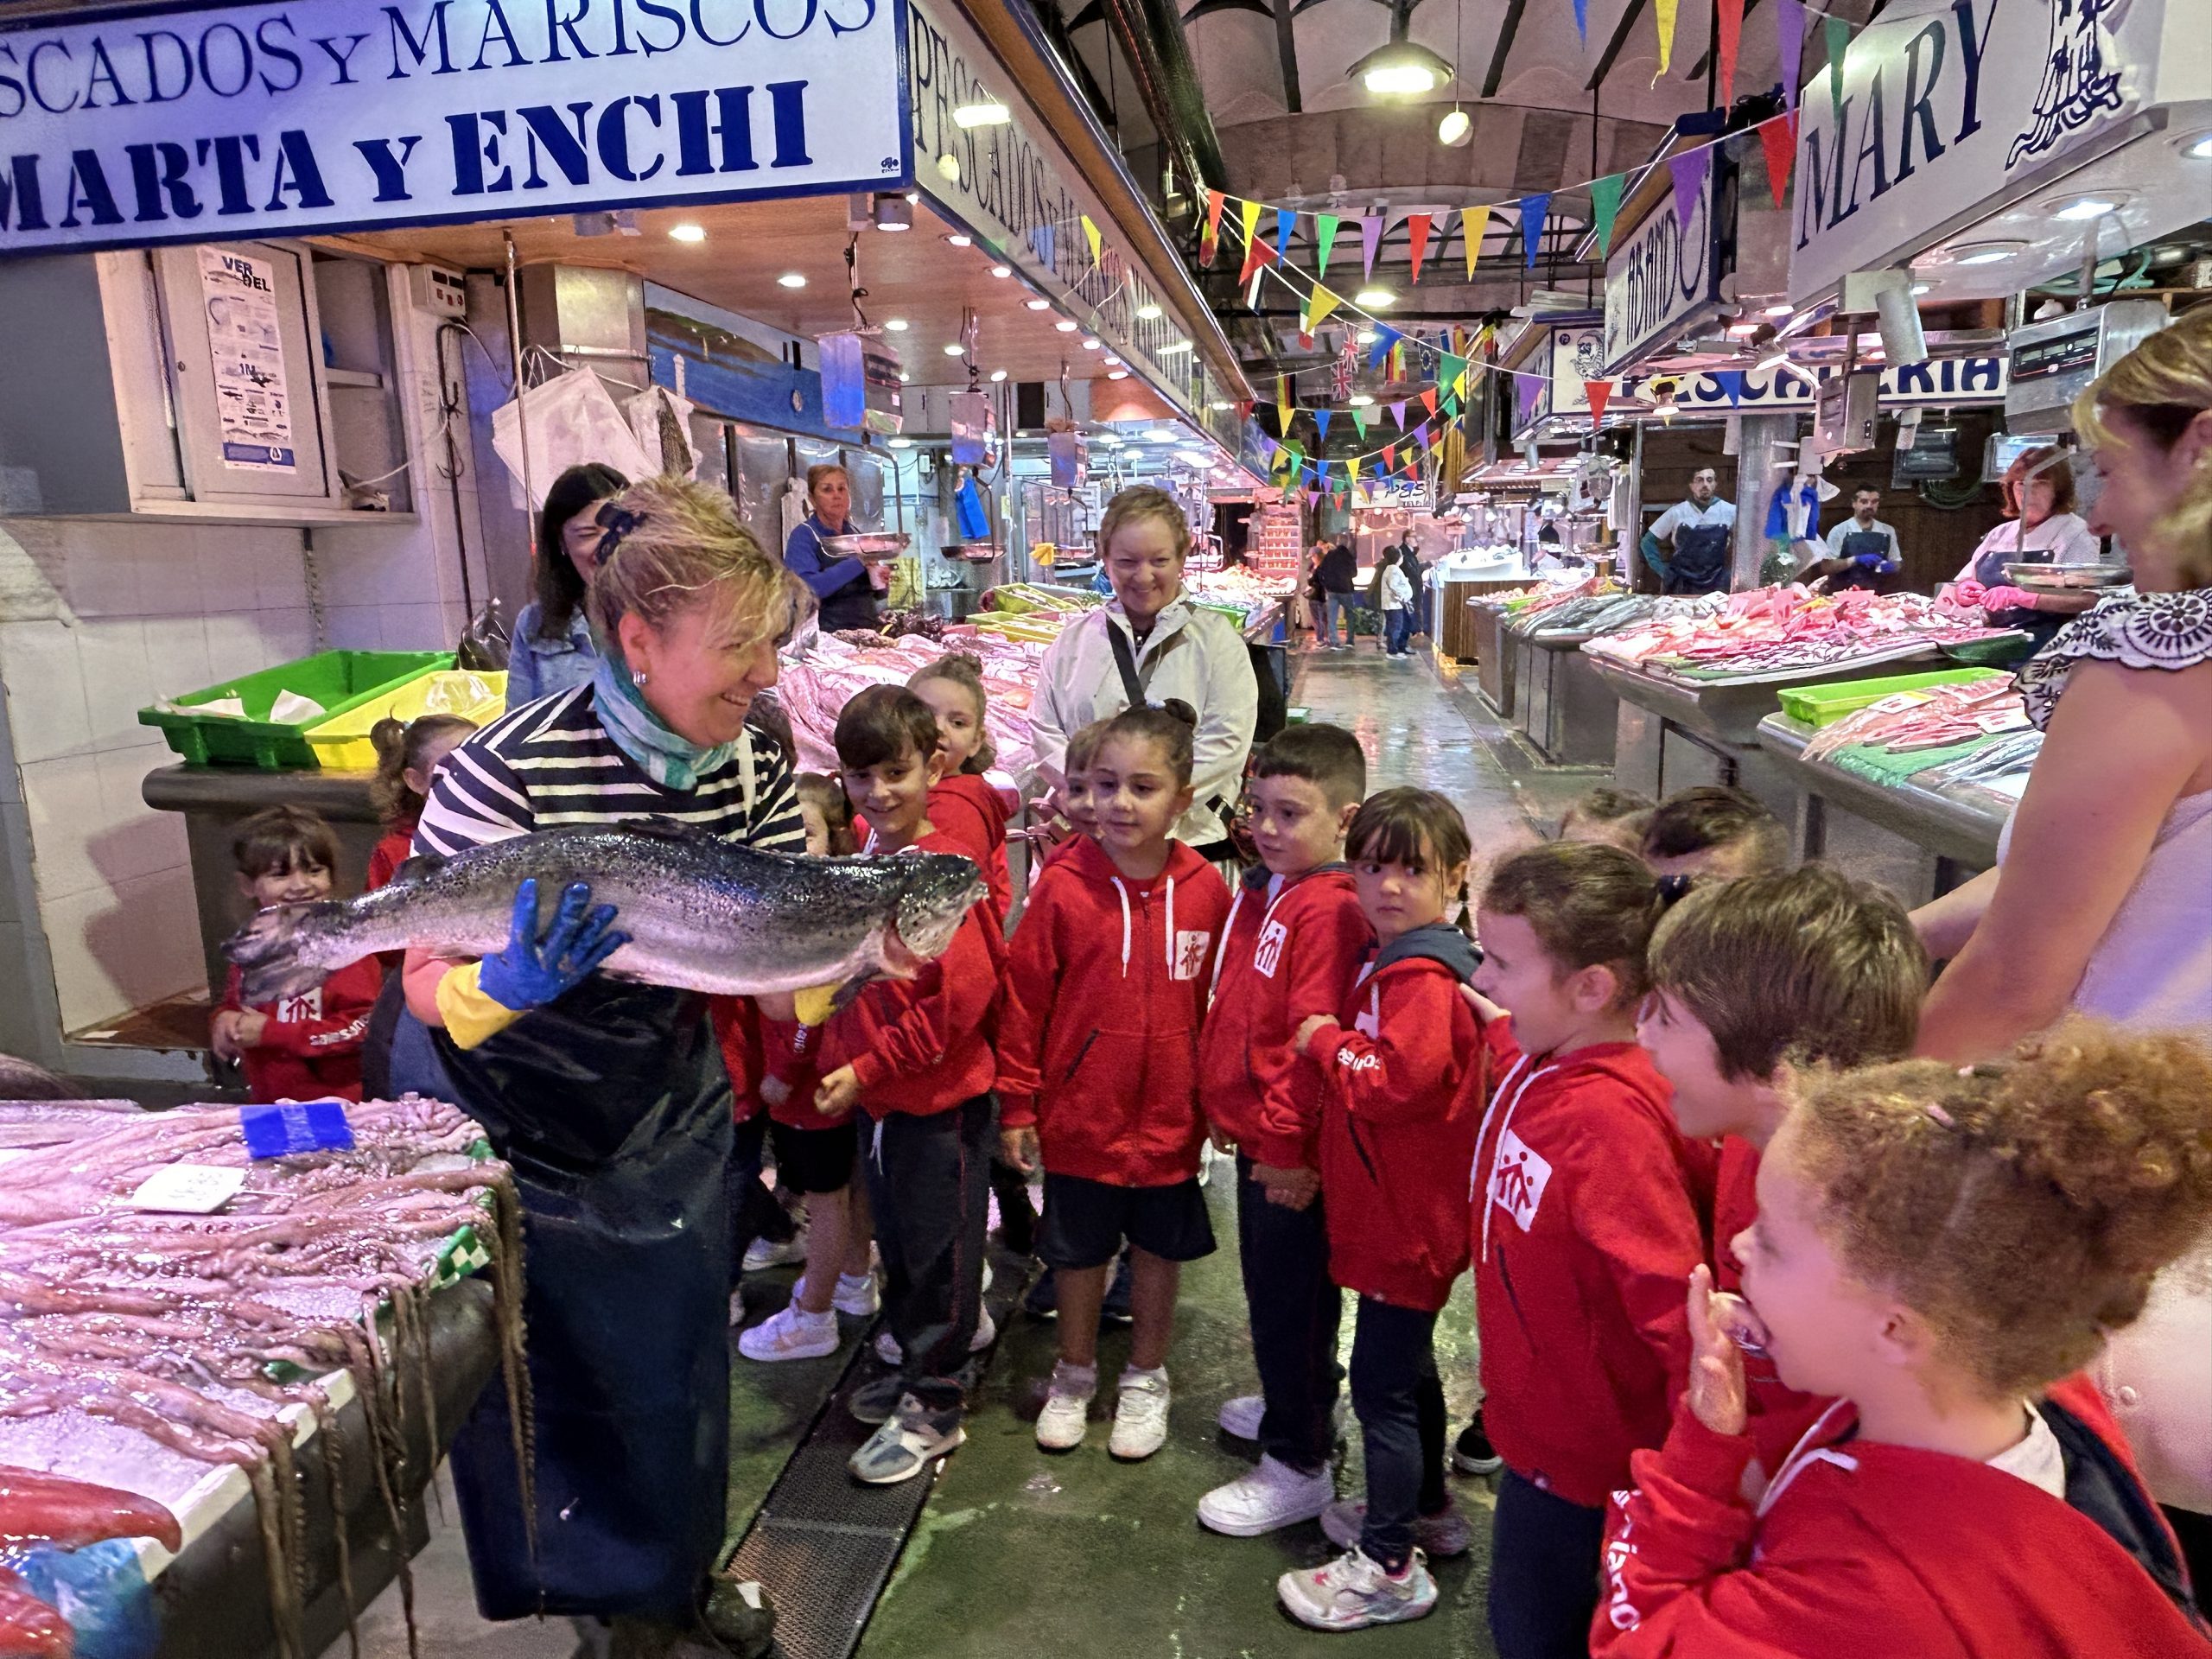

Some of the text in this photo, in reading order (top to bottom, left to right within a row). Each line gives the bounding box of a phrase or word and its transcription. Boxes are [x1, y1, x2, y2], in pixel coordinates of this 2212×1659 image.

[310, 35, 370, 85] Y
[1796, 0, 1998, 251] MARY
[0, 79, 814, 231] MARTA Y ENCHI
[222, 256, 253, 276] VER
[1622, 358, 2000, 404] SCARIA
